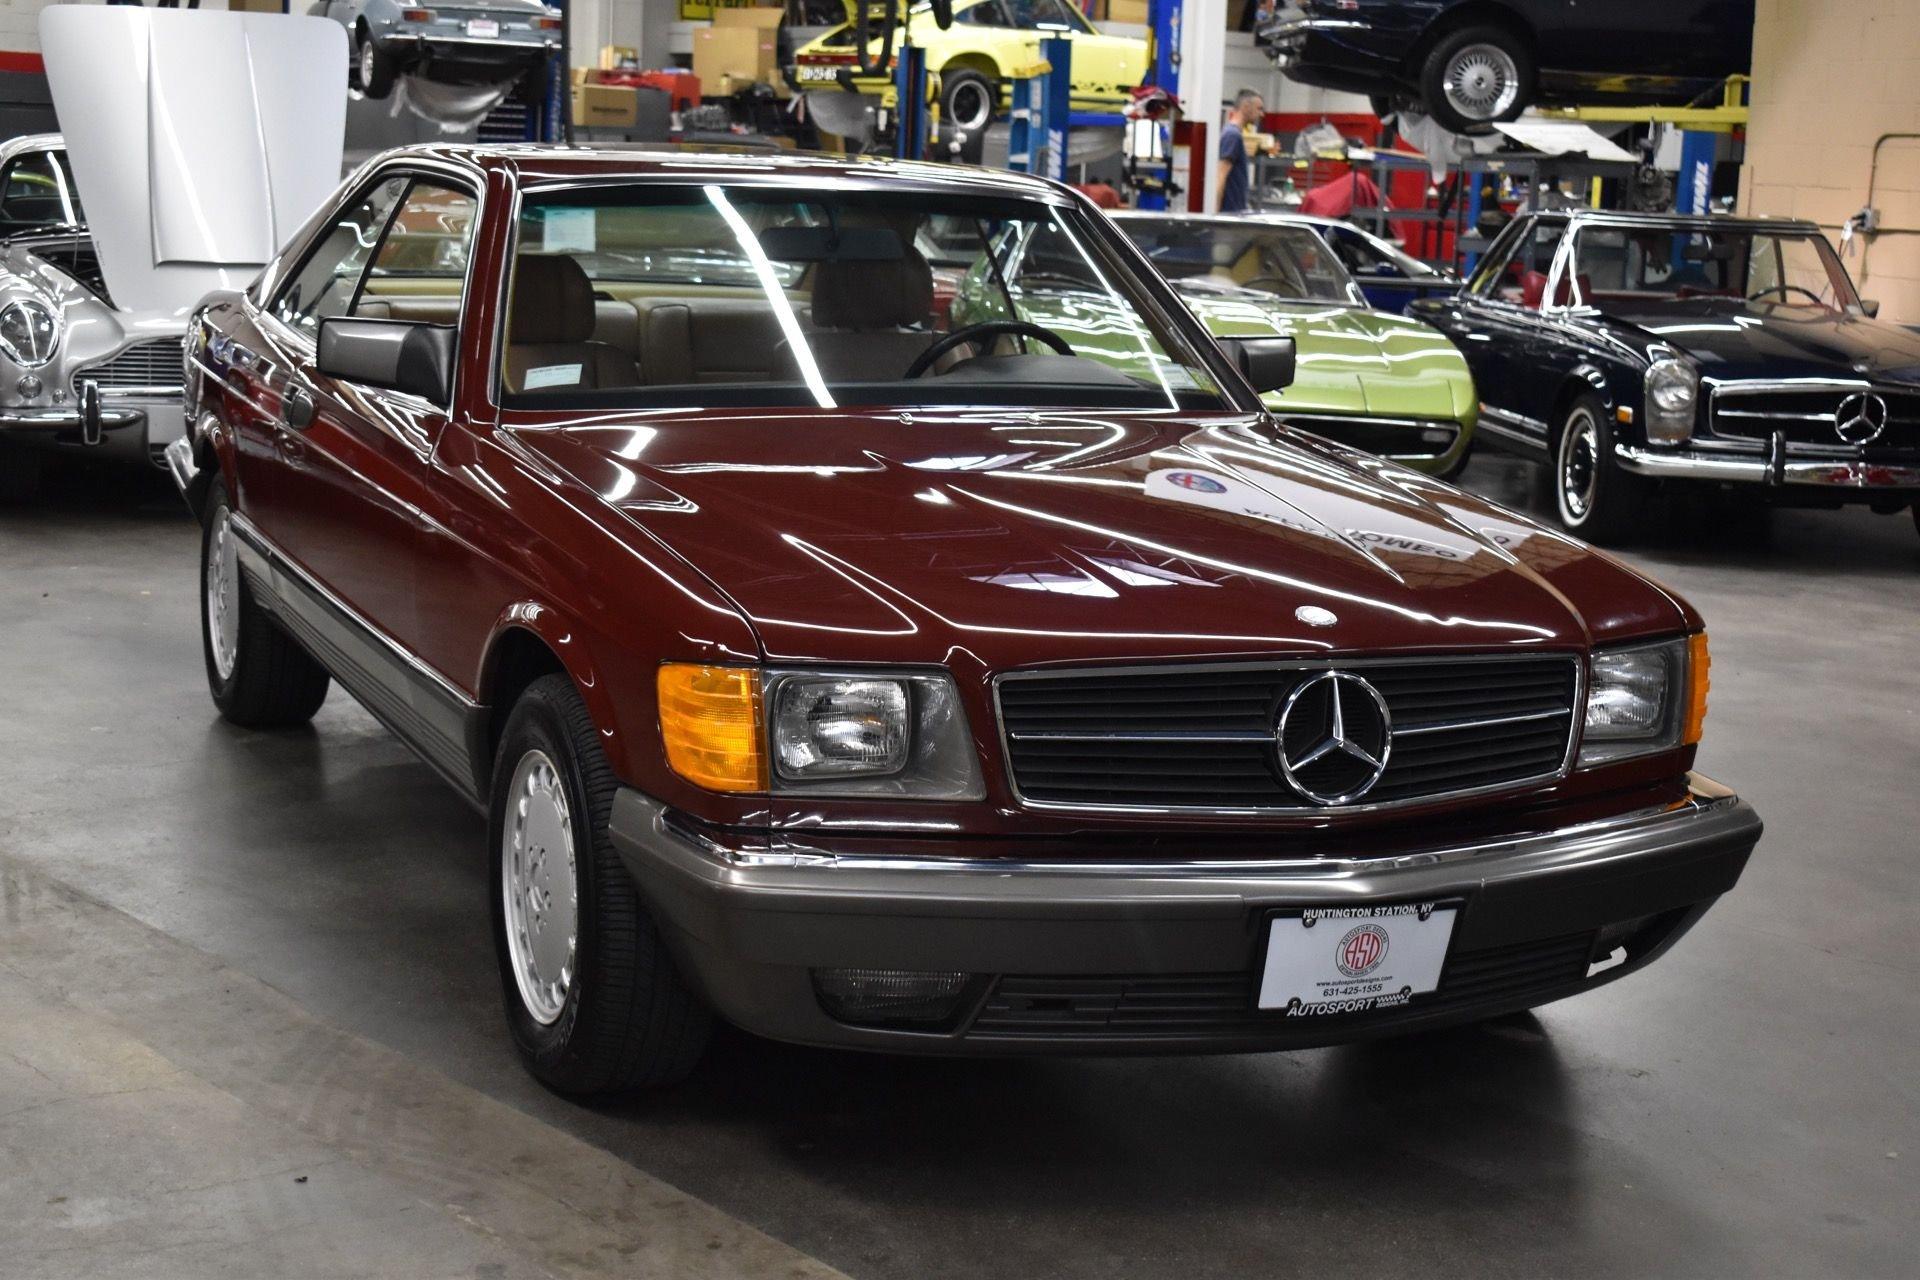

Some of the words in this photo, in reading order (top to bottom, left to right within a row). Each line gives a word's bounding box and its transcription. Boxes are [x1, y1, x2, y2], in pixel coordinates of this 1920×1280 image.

[1303, 907, 1372, 919] HUNTINGTON
[1421, 902, 1435, 912] NY
[1345, 932, 1381, 970] ASD
[1316, 975, 1393, 987] www.autosportdesigns.com
[1323, 984, 1383, 997] 631-425-1555
[1287, 998, 1376, 1017] AUTOSPORT
